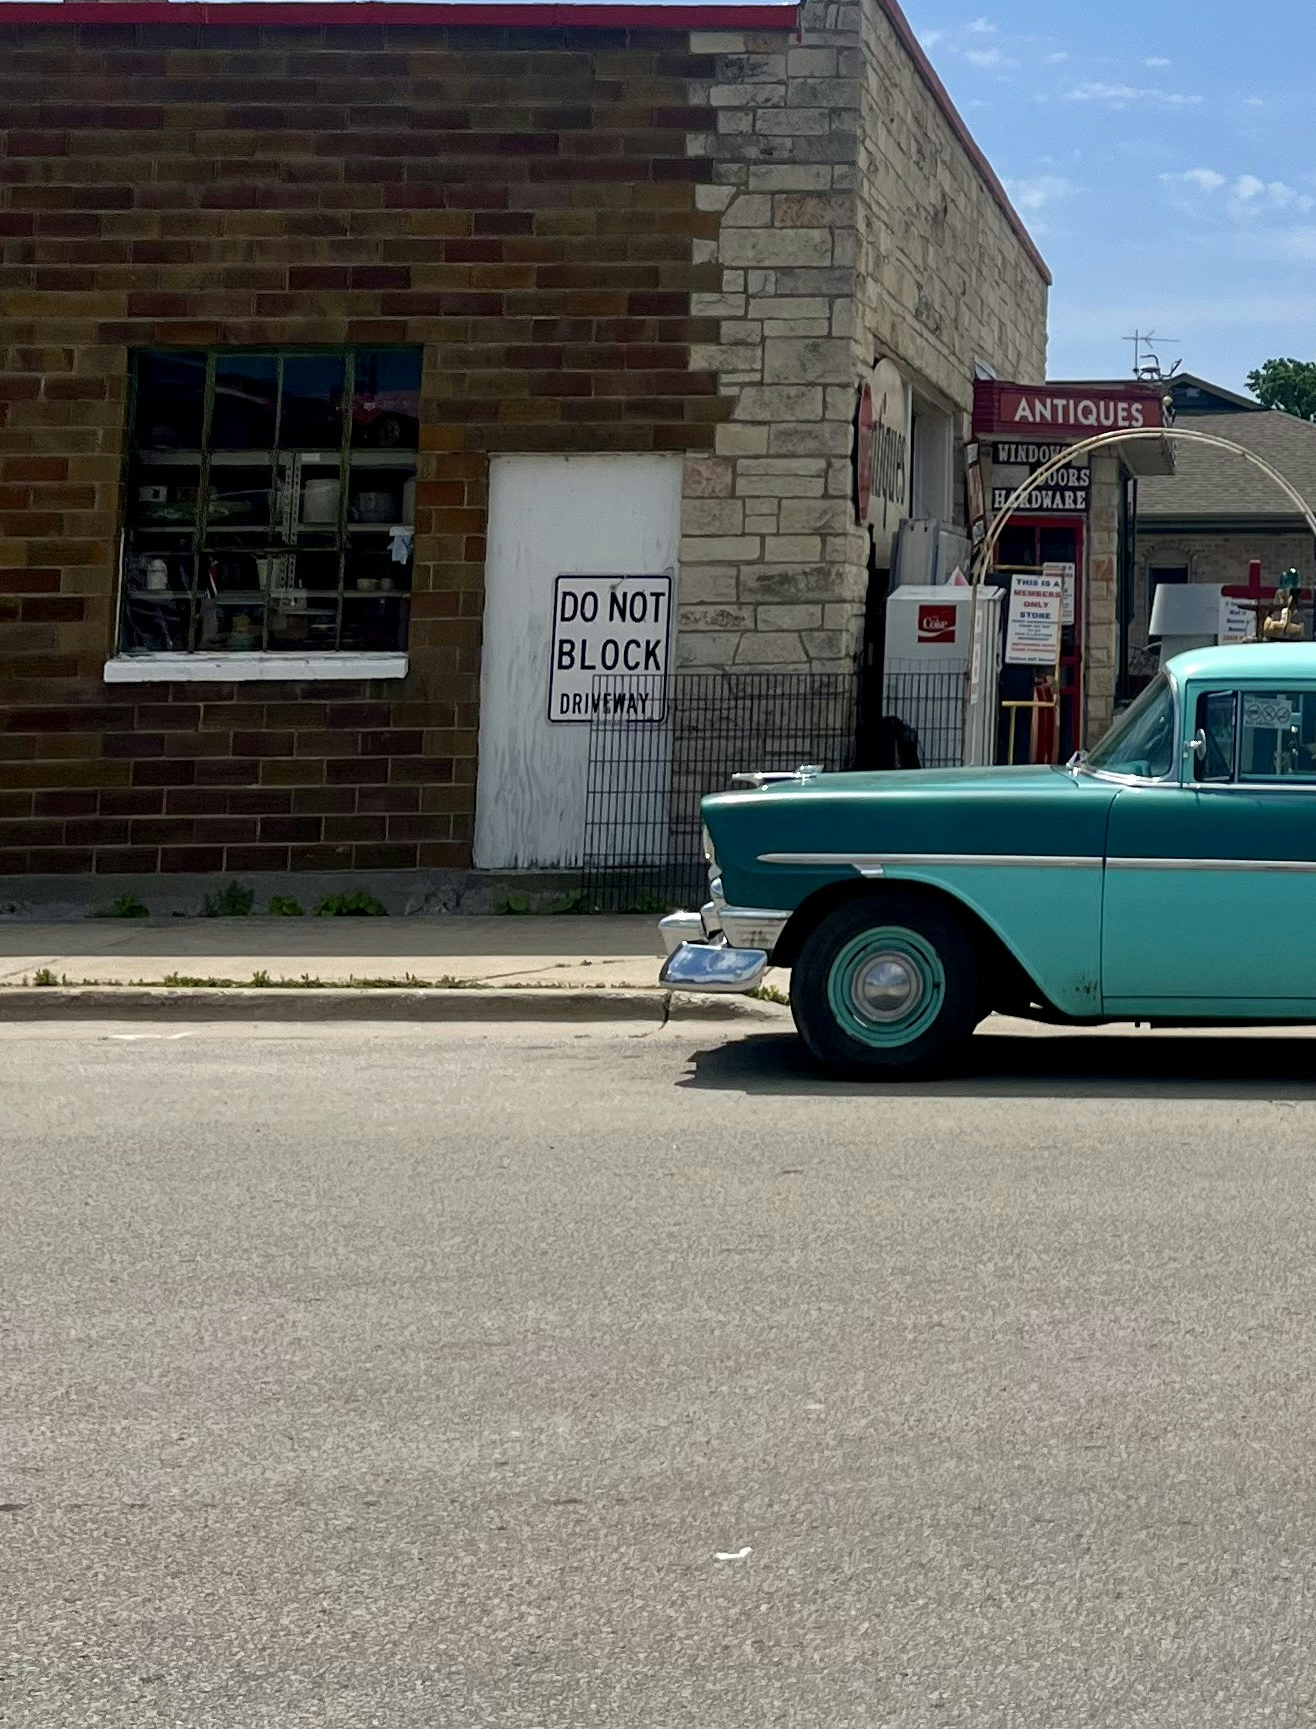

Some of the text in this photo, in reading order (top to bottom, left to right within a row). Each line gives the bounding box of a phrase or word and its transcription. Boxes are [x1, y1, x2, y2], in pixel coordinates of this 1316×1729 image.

[1014, 396, 1144, 427] ANTIQUES
[1017, 578, 1038, 586] THIS
[1013, 589, 1061, 598] MEMBERS
[560, 591, 665, 623] DO NOT
[1020, 611, 1051, 619] STORE
[923, 616, 948, 630] Coke
[558, 639, 661, 671] BLOCK
[560, 693, 649, 714] DRIVEWAY
